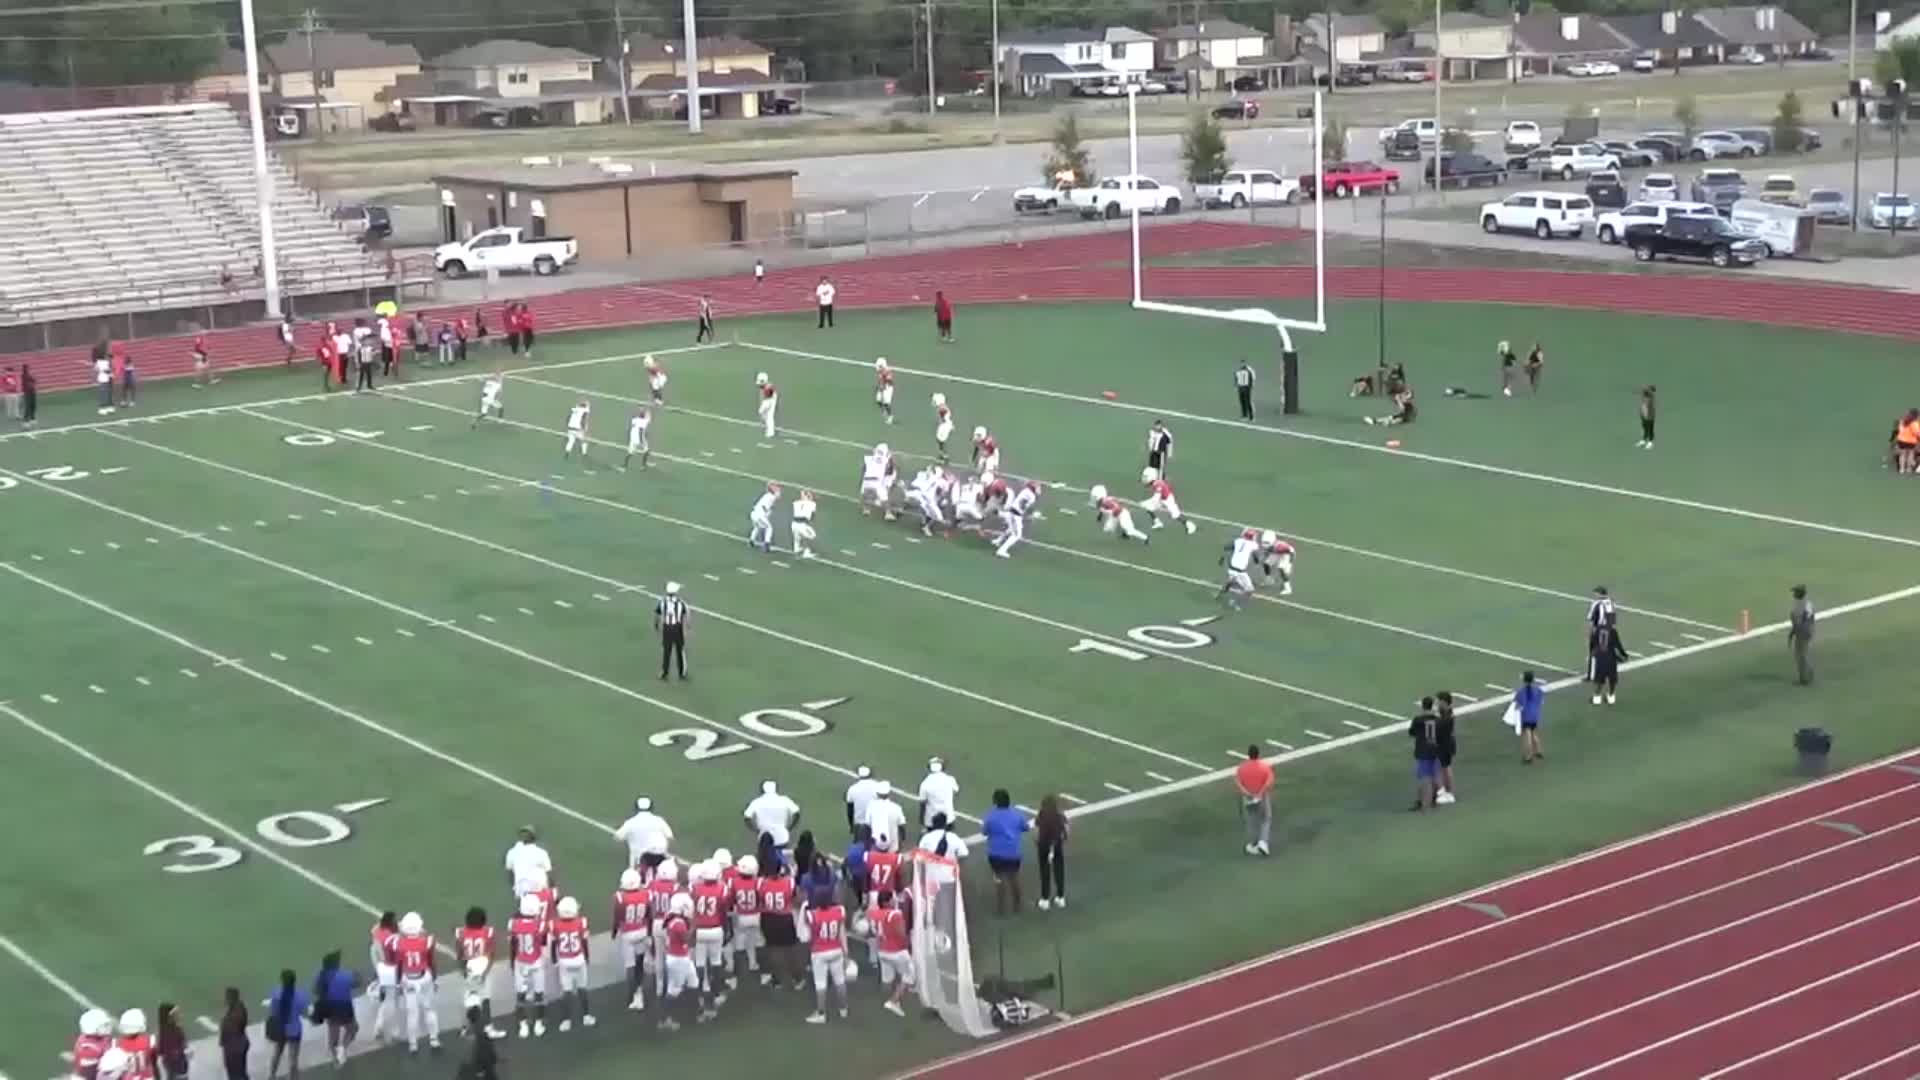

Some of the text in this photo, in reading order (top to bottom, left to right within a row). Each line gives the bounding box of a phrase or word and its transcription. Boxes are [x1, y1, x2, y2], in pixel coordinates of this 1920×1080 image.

[1070, 622, 1211, 661] 10
[649, 707, 829, 761] 20
[143, 810, 353, 874] 30
[871, 863, 893, 884] 47
[696, 895, 718, 917] 43
[559, 931, 581, 953] 25
